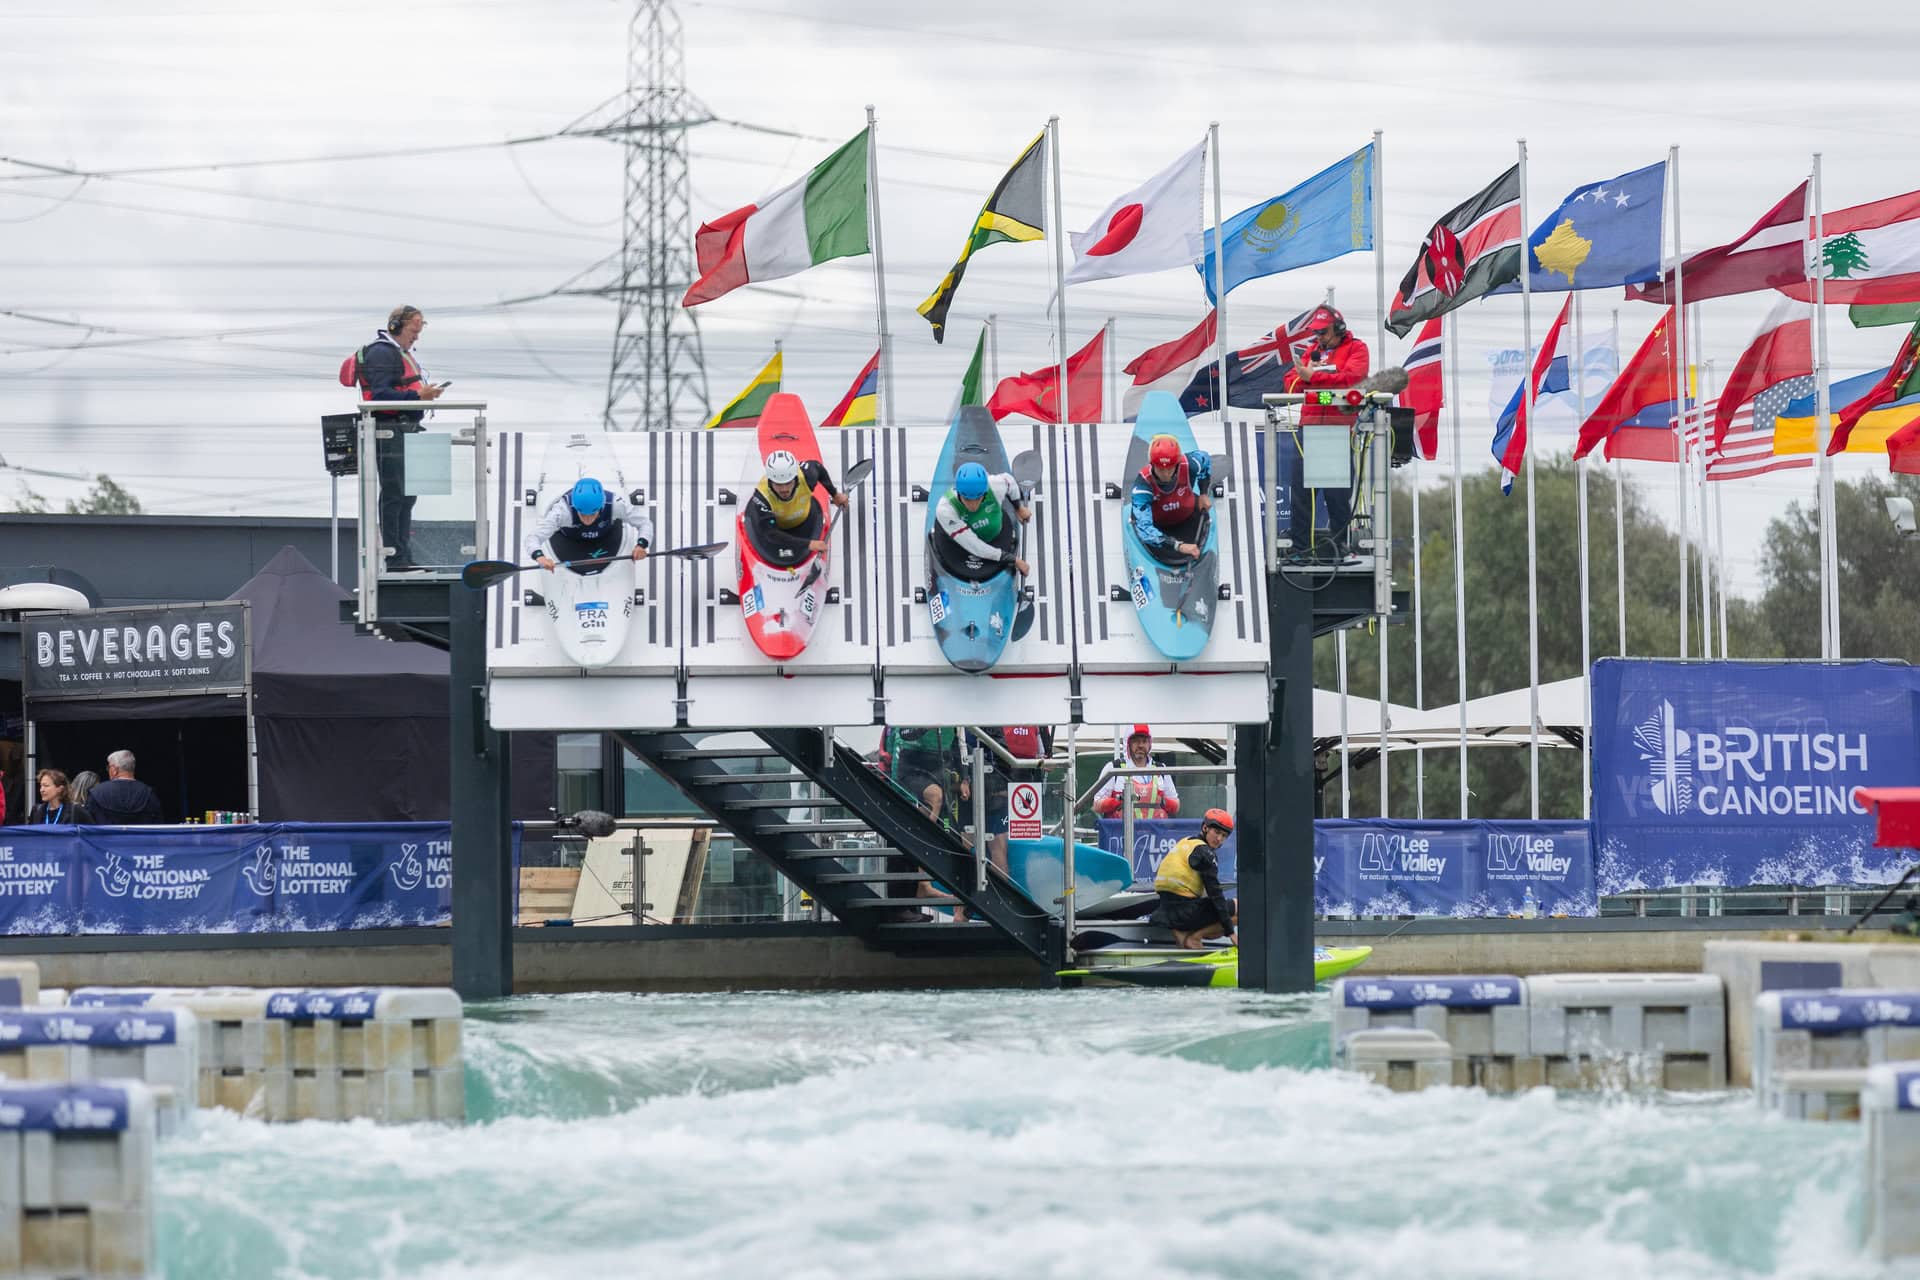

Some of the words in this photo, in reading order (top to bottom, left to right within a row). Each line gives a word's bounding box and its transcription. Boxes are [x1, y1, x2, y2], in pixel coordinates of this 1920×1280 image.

[744, 593, 756, 616] CHI
[1132, 584, 1147, 609] GBR
[578, 609, 607, 620] FRA
[931, 597, 944, 623] GBR
[581, 620, 605, 628] Gill
[37, 621, 235, 667] BEVERAGES
[59, 674, 70, 682] TEA
[80, 673, 103, 681] COFFEE
[113, 672, 125, 680] HOT
[127, 670, 161, 679] CHOCOLATE
[171, 668, 186, 677] SOFT
[187, 667, 210, 676] DRINKS
[1697, 727, 1868, 782] BRITISH
[1149, 834, 1177, 853] Lee
[1401, 835, 1429, 853] Lee
[1525, 835, 1554, 853] Lee
[281, 846, 310, 860] THE
[0, 862, 65, 878] ATIONAL
[133, 855, 165, 869] THE
[281, 862, 357, 877] NATIONAL
[1400, 854, 1447, 875] Valley
[1525, 854, 1572, 874] Valley
[132, 869, 211, 885] NATIONAL
[0, 880, 54, 896] OTTERY
[133, 884, 202, 900] LOTTERY
[281, 879, 349, 894] LOTTERY
